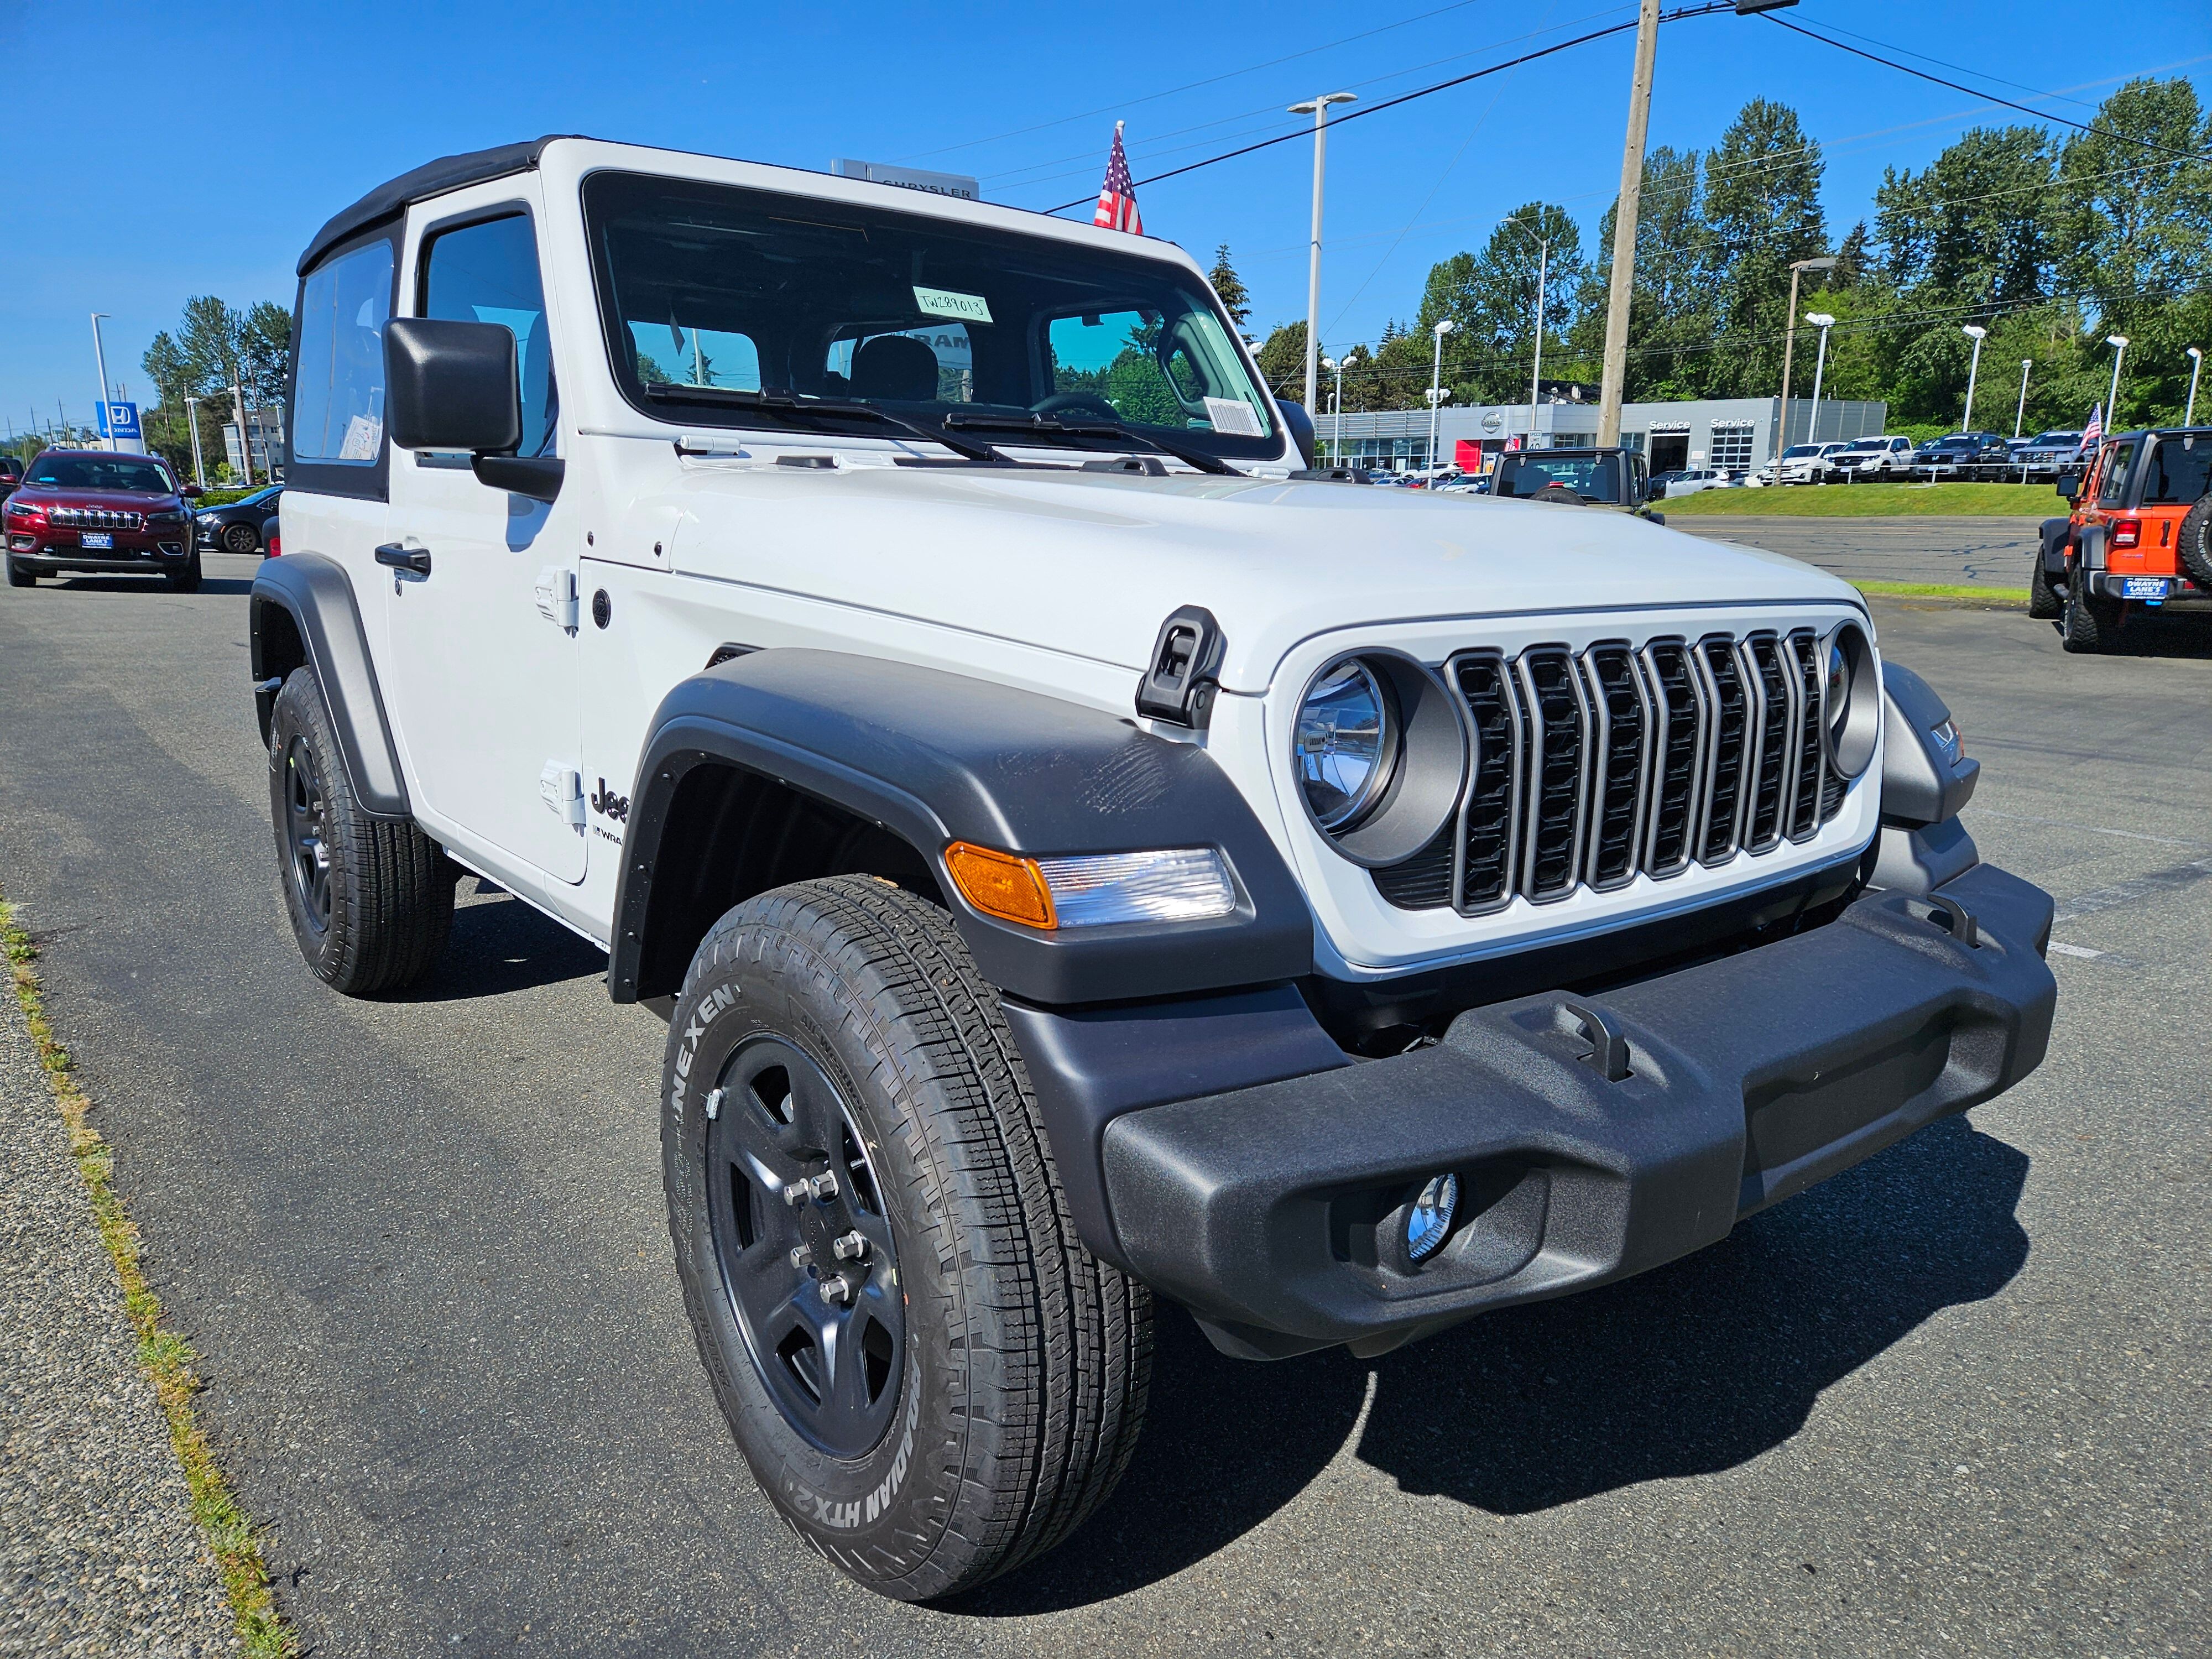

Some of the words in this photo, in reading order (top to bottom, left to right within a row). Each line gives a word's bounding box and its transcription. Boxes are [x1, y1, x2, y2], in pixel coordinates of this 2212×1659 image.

[914, 334, 970, 349] RAM
[1649, 420, 1691, 430] Service
[1710, 418, 1755, 428] Service
[591, 777, 630, 824] Jee
[601, 828, 623, 846] WRA
[671, 983, 736, 1113] NEXEN
[867, 1350, 921, 1523] ROADIAN
